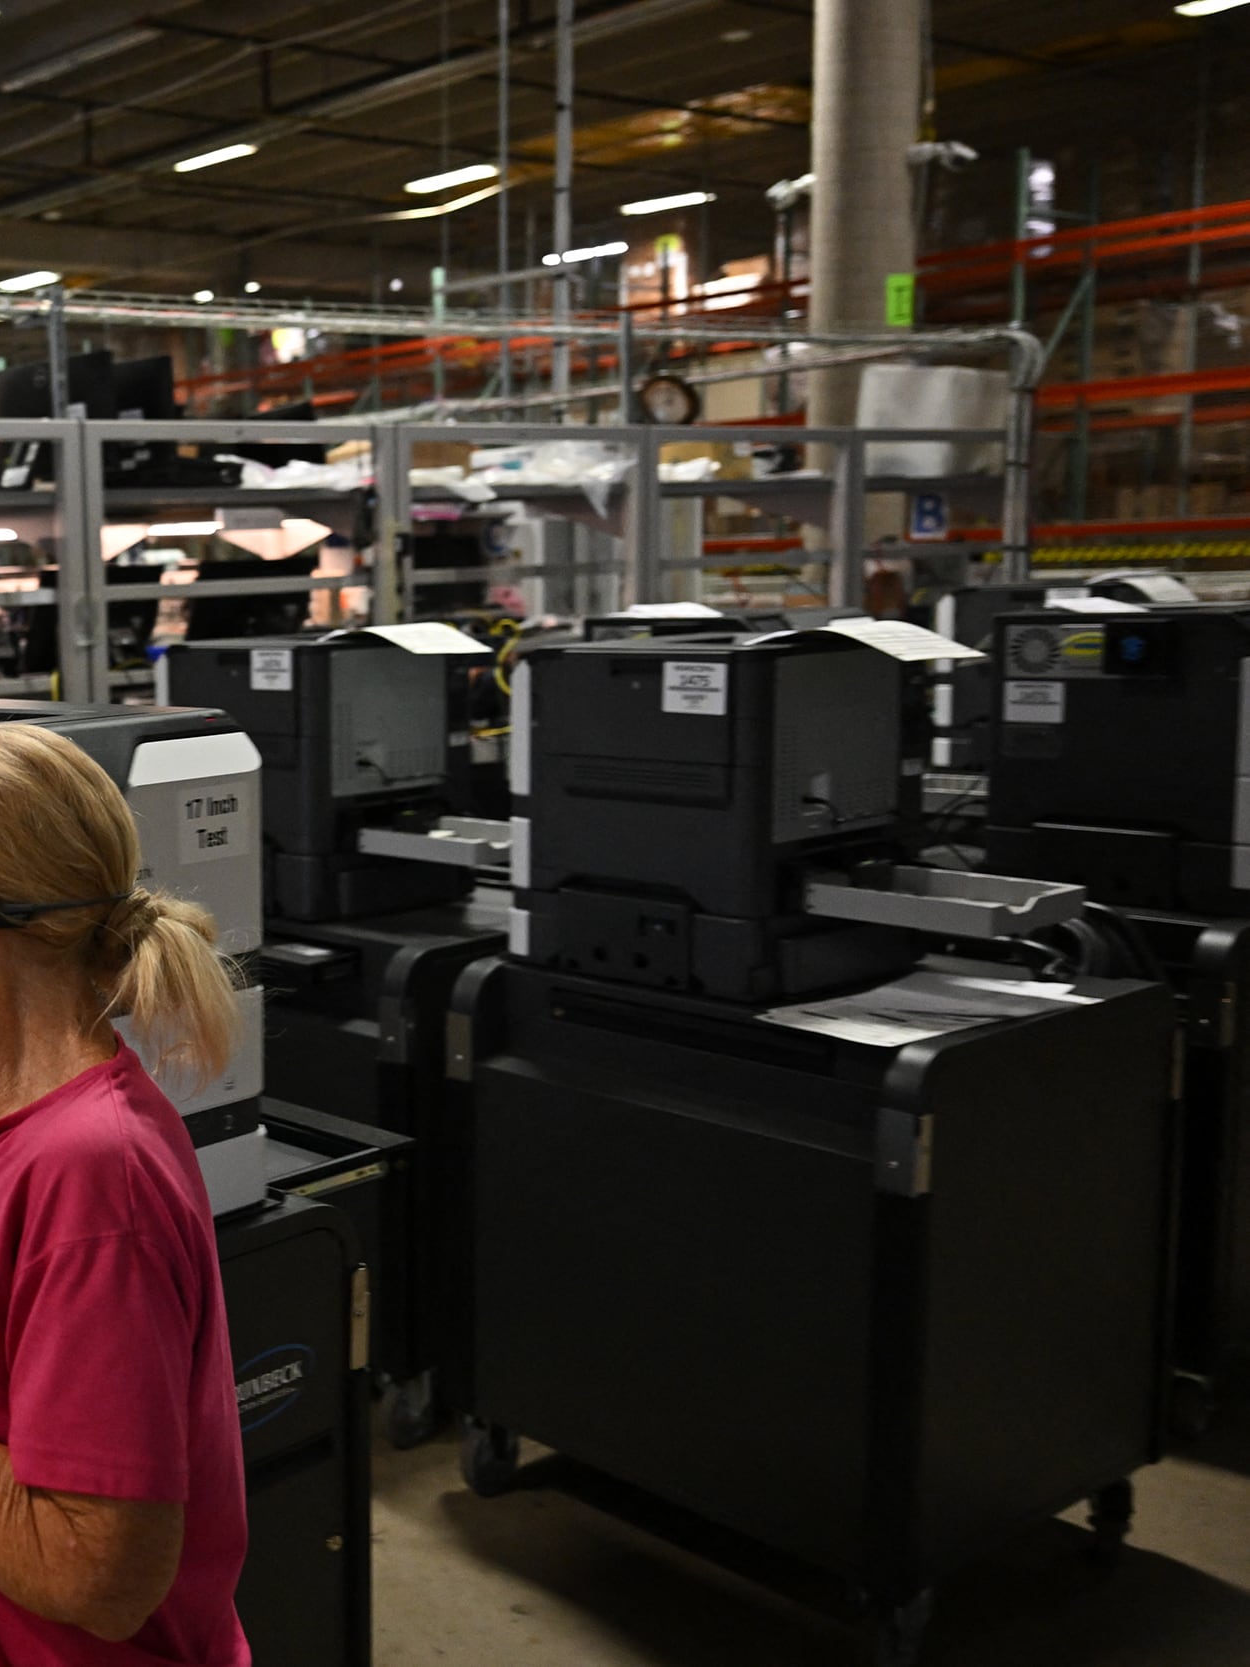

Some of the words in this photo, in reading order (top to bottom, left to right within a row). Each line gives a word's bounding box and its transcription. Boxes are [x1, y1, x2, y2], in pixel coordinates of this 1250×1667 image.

[185, 798, 204, 820] 17
[206, 794, 238, 817] Inch
[196, 826, 229, 849] Test
